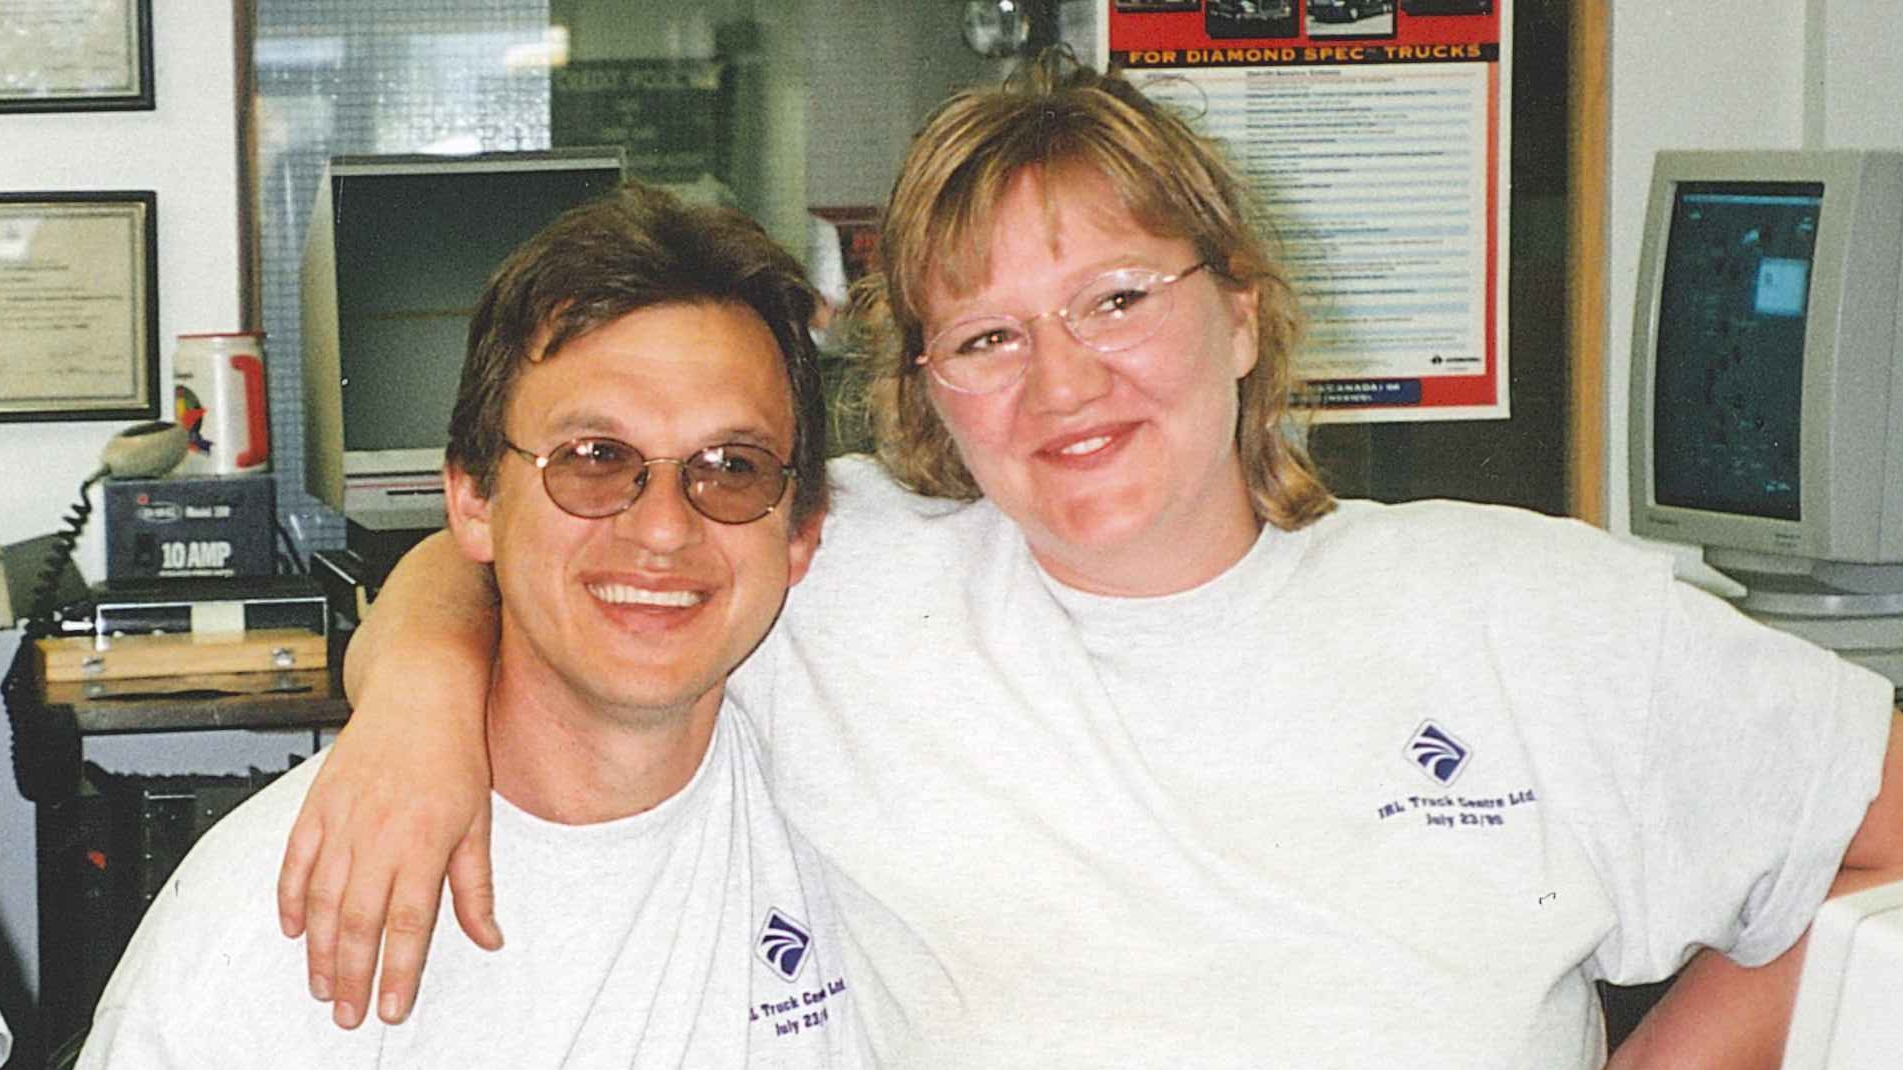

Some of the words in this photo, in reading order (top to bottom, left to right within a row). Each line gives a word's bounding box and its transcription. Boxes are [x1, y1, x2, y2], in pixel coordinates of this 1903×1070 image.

[1129, 51, 1177, 64] FOR
[1186, 49, 1297, 64] DIAMOND
[1385, 44, 1482, 60] TRUCKS
[161, 541, 186, 569] 10
[186, 541, 232, 569] AMP
[1408, 795, 1455, 808] Truck
[1426, 812, 1455, 828] July
[760, 995, 800, 1017] Truck
[775, 1019, 800, 1036] July
